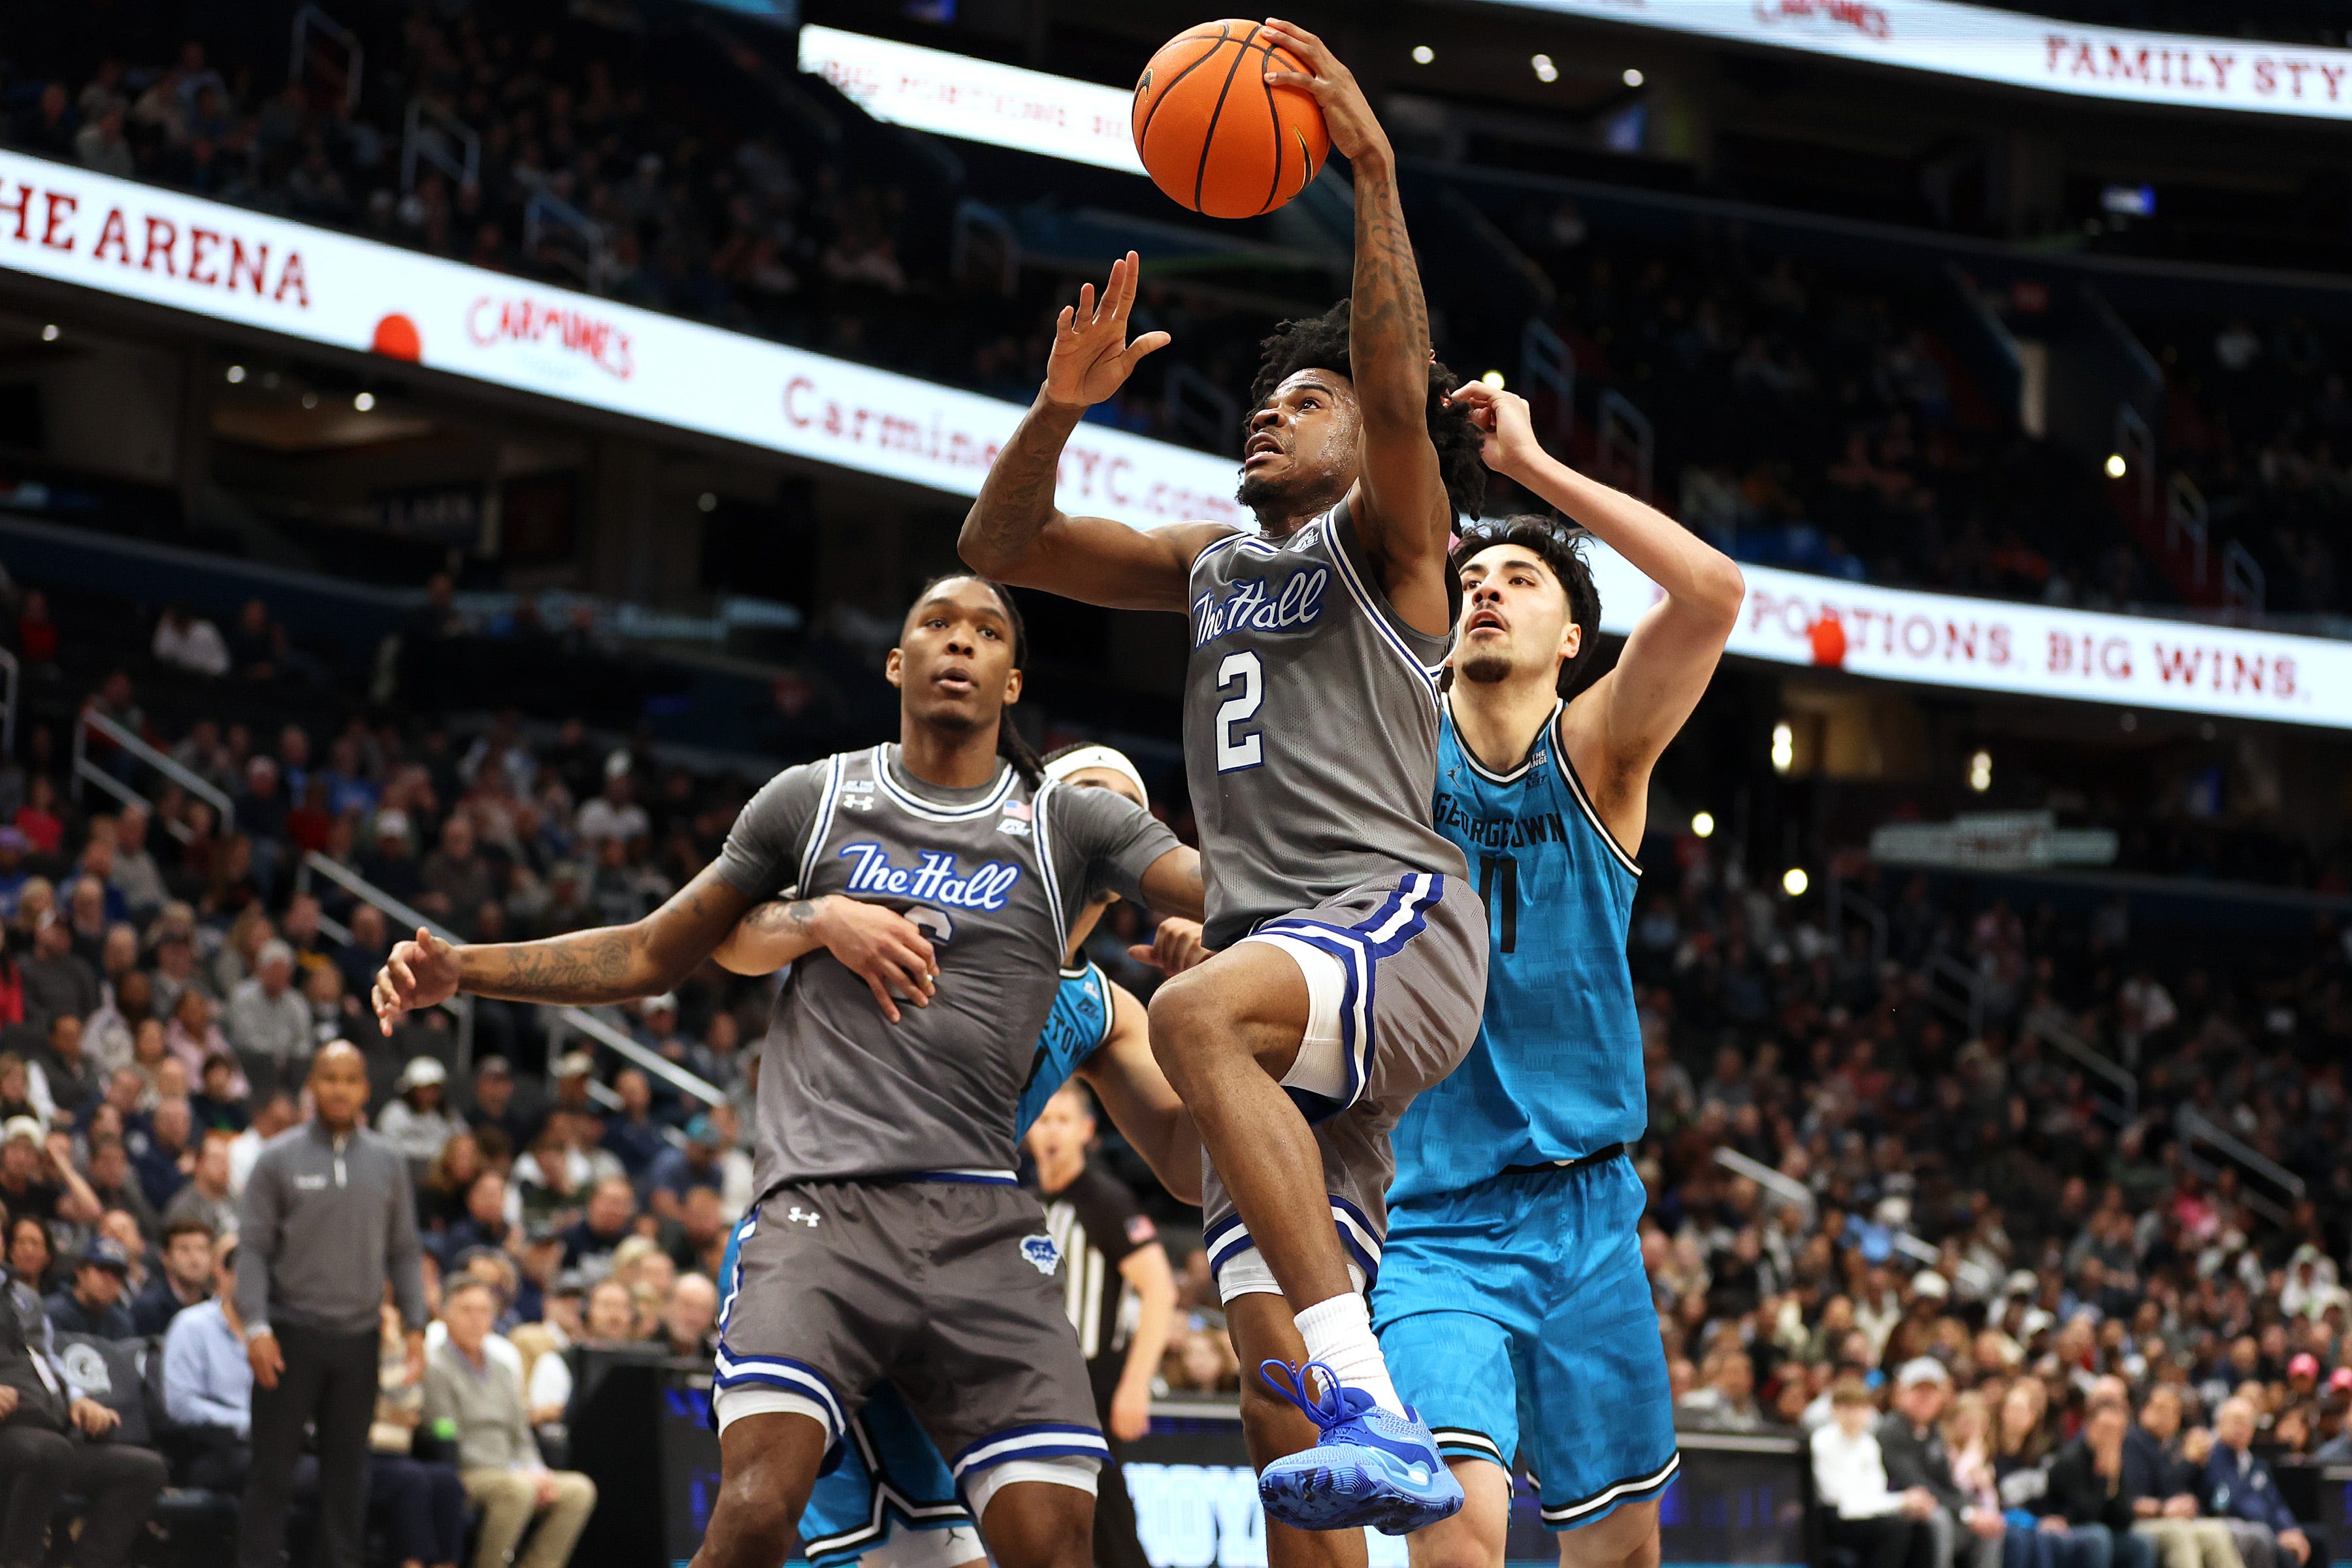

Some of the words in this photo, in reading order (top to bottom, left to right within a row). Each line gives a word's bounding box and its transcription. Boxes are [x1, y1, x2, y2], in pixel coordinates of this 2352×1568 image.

[2046, 35, 2234, 90] FAMILY
[93, 208, 310, 308] ARENA
[1192, 588, 1226, 649] The
[1226, 566, 1329, 632] Hall
[2048, 631, 2132, 679] BIG
[1215, 648, 1266, 776] 2
[1532, 749, 1546, 761] THE
[1434, 792, 1566, 848] GEORGEOWN
[840, 843, 910, 894] The
[910, 851, 1021, 911] Hall
[1478, 855, 1518, 954] 11
